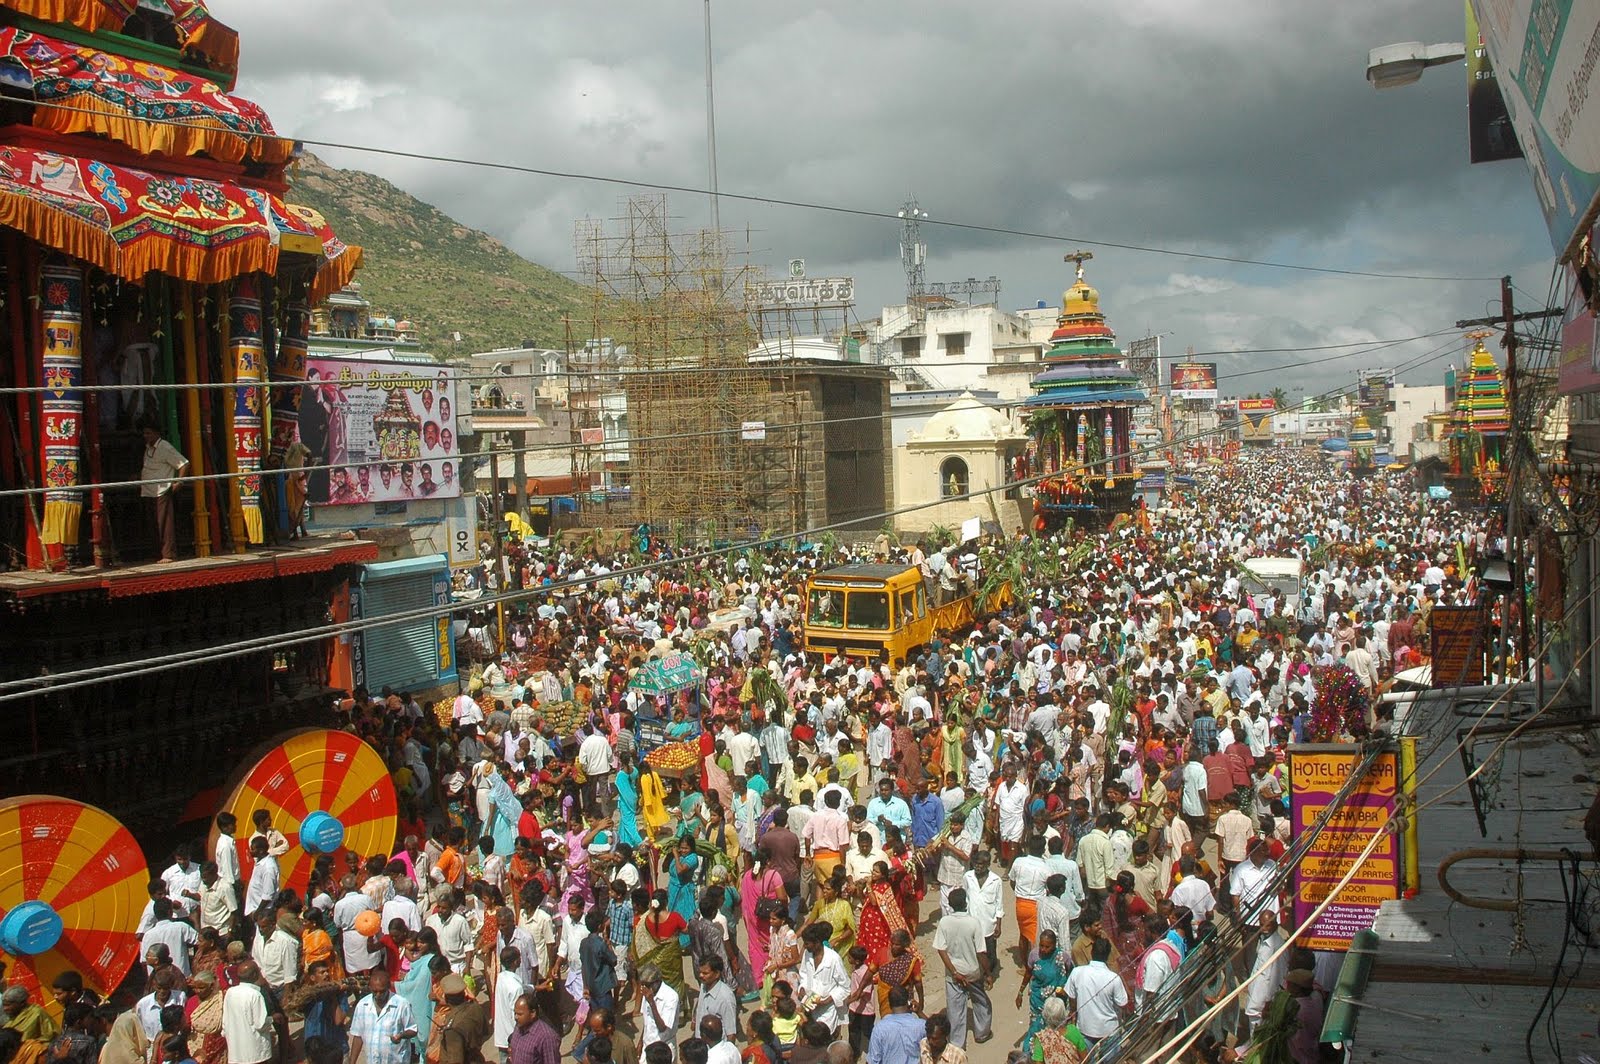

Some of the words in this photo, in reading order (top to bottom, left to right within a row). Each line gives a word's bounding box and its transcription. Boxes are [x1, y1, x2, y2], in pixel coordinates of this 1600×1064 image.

[661, 655, 682, 670] JOY
[1294, 762, 1333, 776] HOTEL
[1337, 763, 1394, 777] ASEYA
[1358, 811, 1379, 822] BAR
[1332, 833, 1339, 841] &
